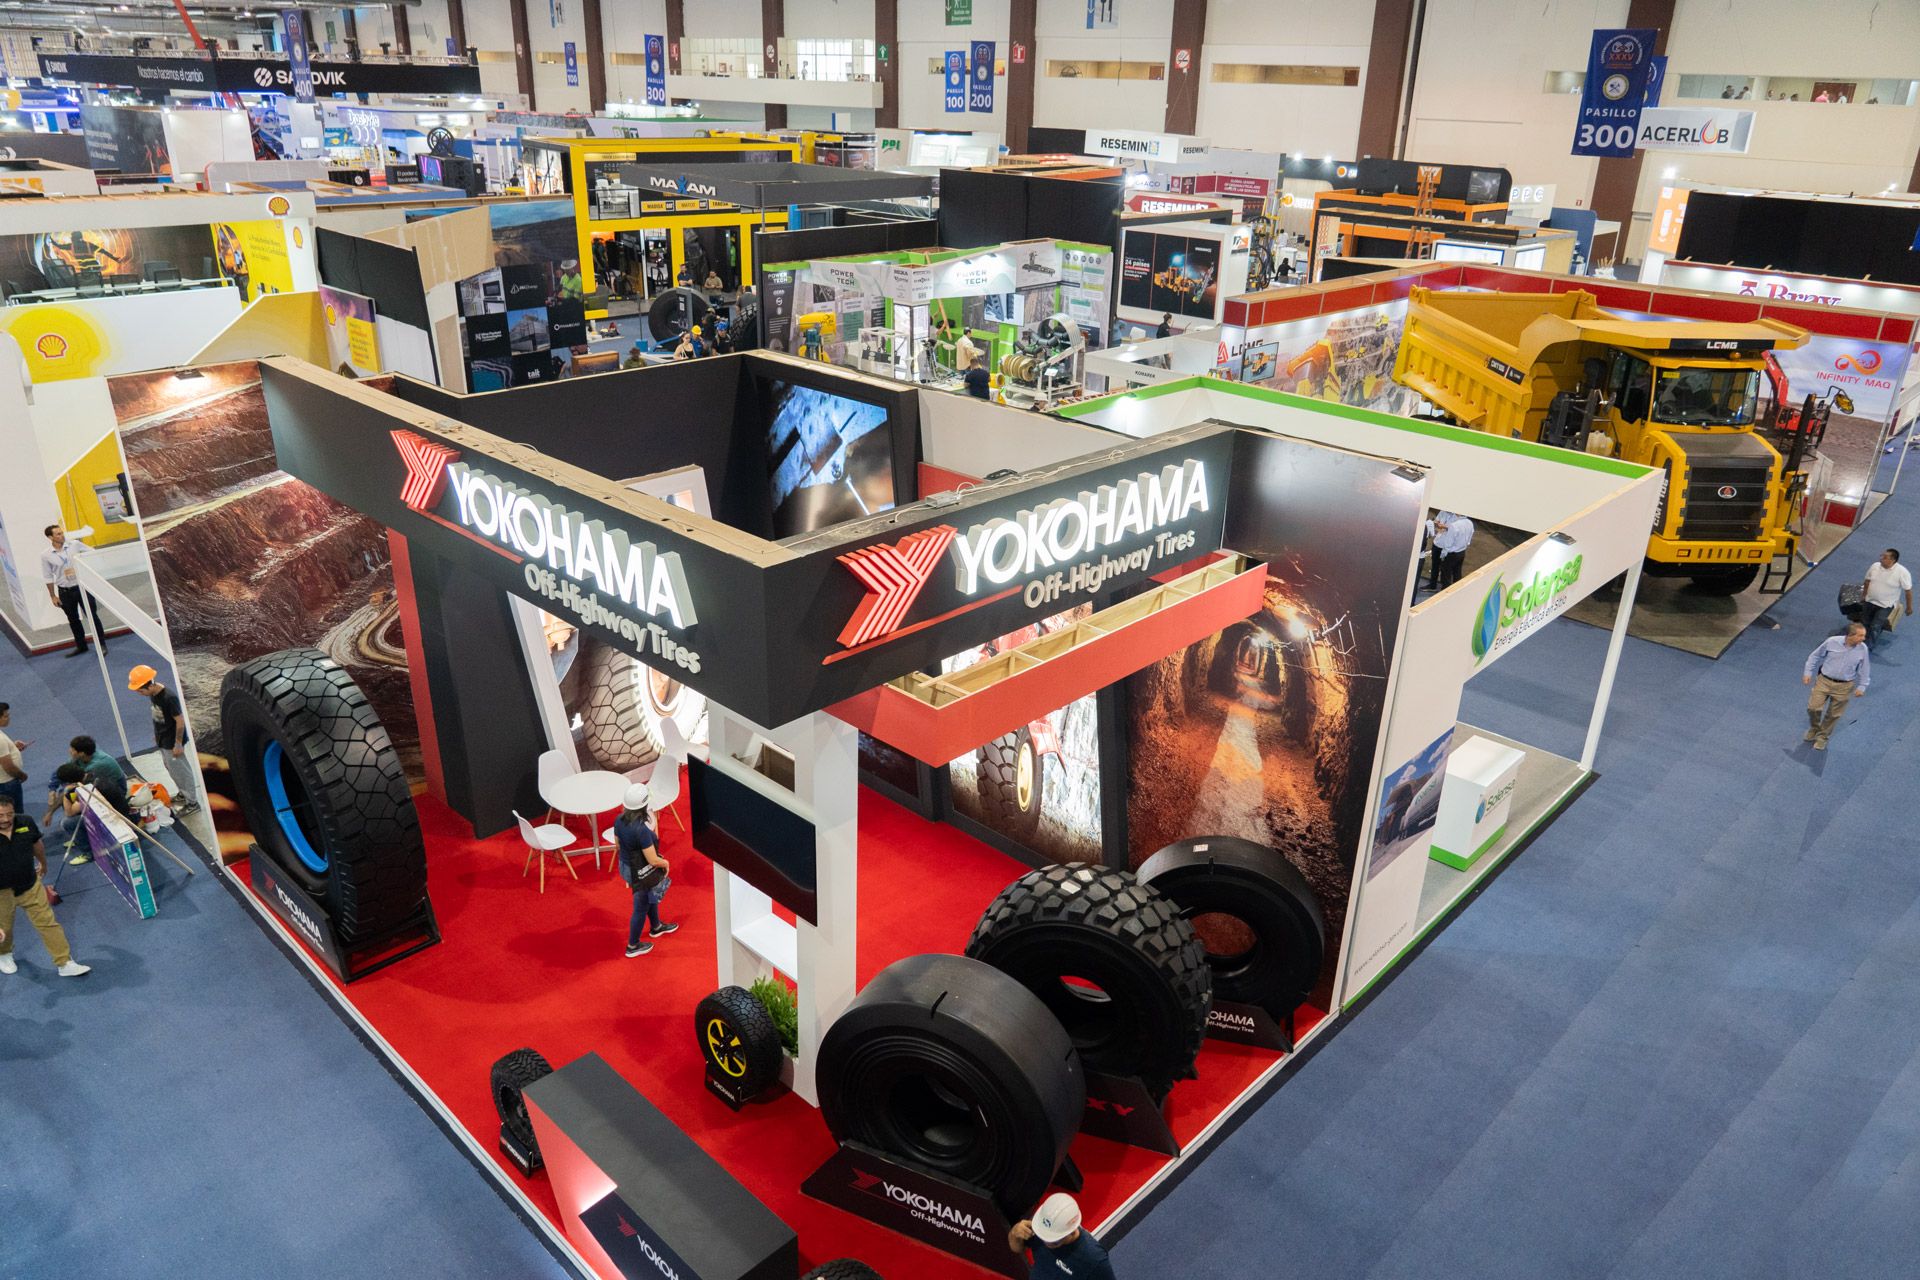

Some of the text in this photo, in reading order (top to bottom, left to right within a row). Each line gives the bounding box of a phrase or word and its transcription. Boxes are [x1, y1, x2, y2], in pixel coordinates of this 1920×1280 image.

[137, 66, 158, 80] Nosotros
[157, 67, 180, 81] hacemos
[184, 68, 204, 82] cambio
[295, 80, 312, 96] 400
[648, 86, 664, 102] 300
[946, 96, 964, 108] 100
[970, 94, 992, 108] 200
[1586, 108, 1636, 118] PASILLO
[1578, 124, 1634, 148] 300
[1100, 138, 1148, 152] RESEMIN
[1183, 146, 1204, 154] RESEMIN
[1142, 200, 1196, 214] RESEMIN
[830, 269, 854, 278] POWER
[964, 277, 988, 285] TECH
[836, 278, 854, 286] TECH
[1706, 341, 1738, 349] LCMG
[1816, 371, 1891, 389] INFINITY MAQ
[953, 458, 1210, 595] YOKOHAMA
[447, 462, 698, 630] YOKOHAMA
[1024, 528, 1196, 609] Off-Highway Tires
[524, 563, 701, 674] Off-Highway Tires
[275, 884, 322, 942] YOKOHAMA
[883, 1181, 985, 1234] YOKOHAMA
[910, 1209, 985, 1244] Off-Highway Tires
